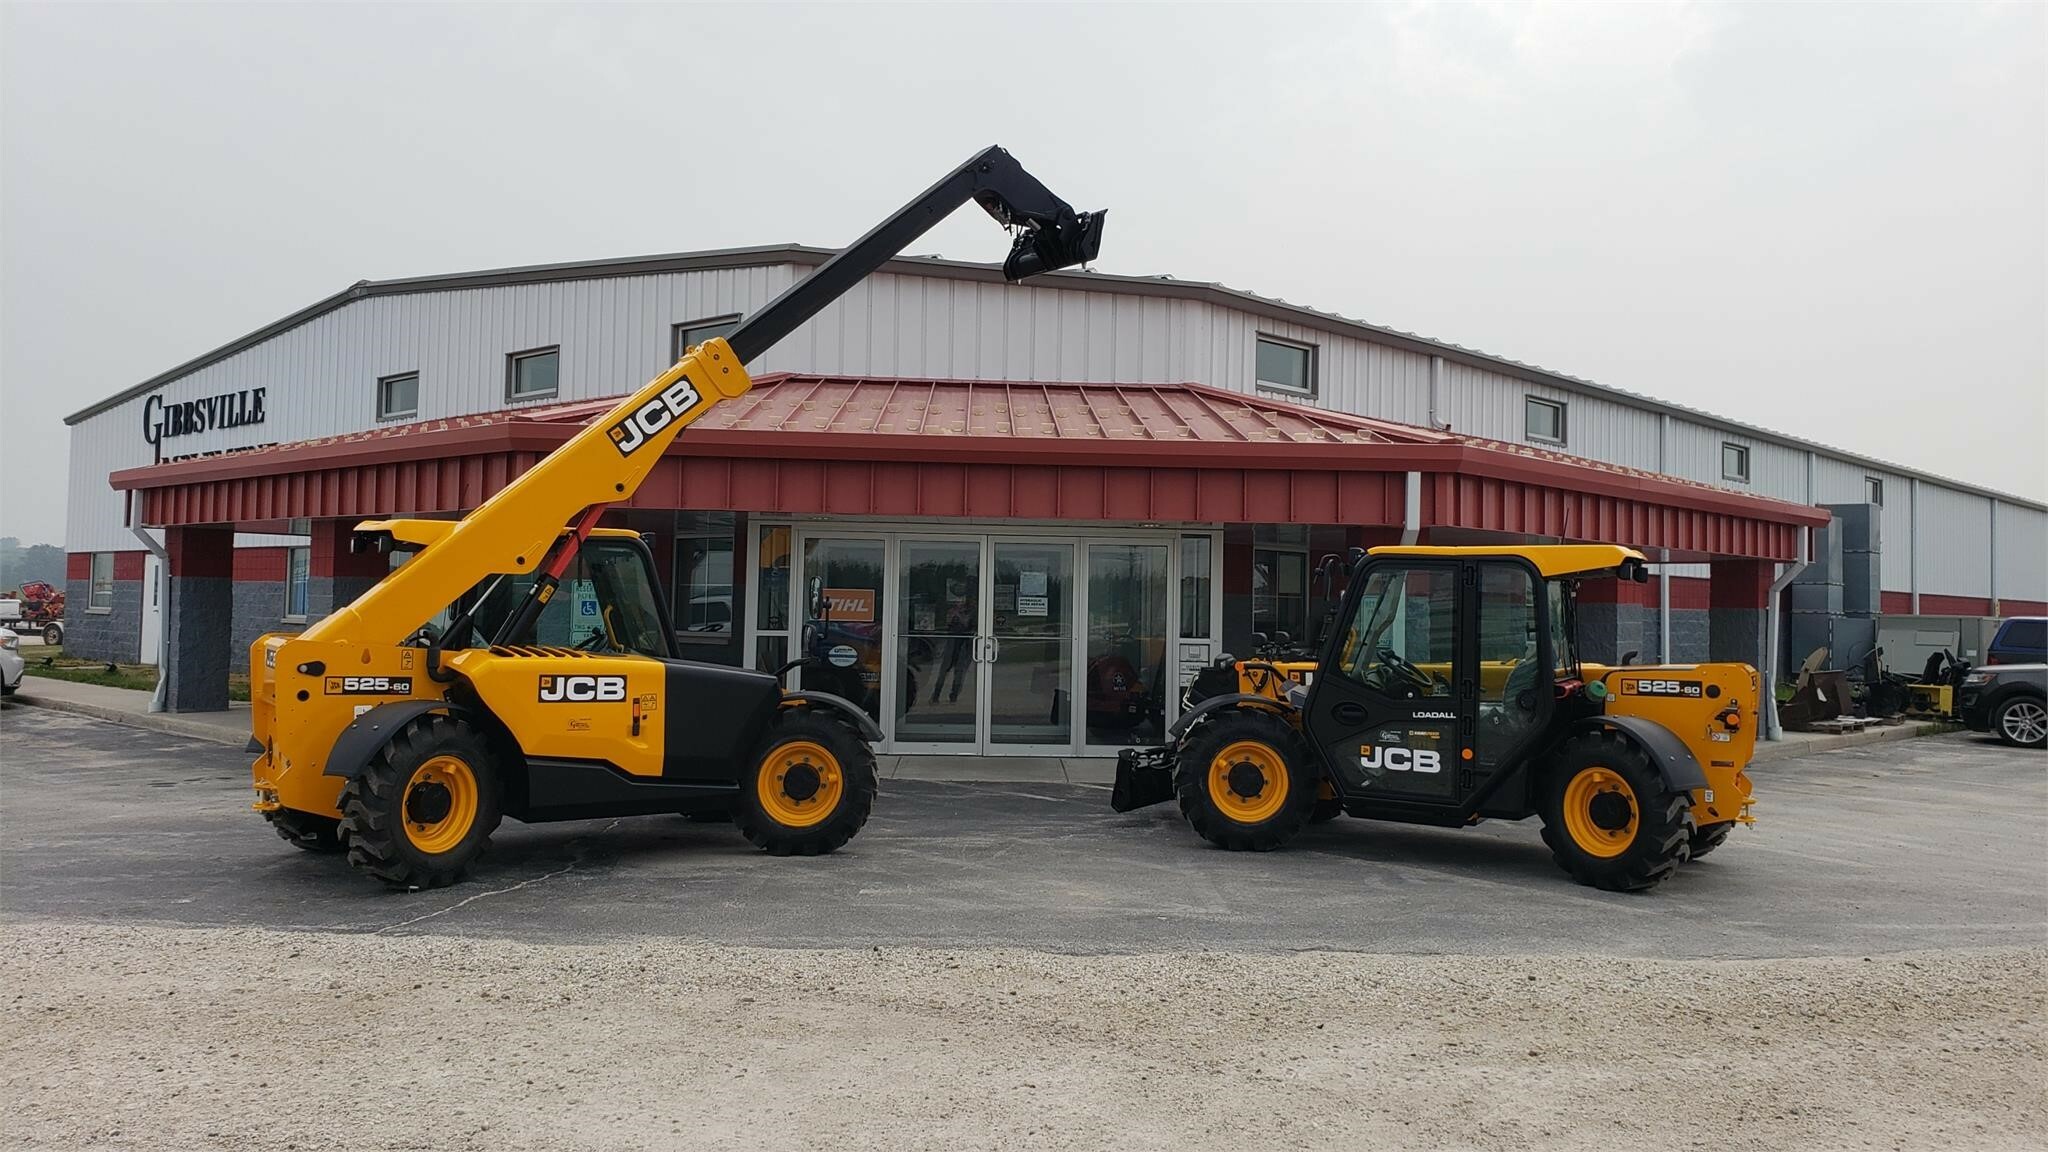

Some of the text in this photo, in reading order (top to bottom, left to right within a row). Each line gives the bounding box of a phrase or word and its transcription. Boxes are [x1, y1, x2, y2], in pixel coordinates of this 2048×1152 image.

[143, 387, 266, 466] GIBBSVILLE
[619, 380, 698, 453] JCB
[344, 677, 410, 691] 525-60
[540, 676, 625, 700] JCB
[1638, 680, 1700, 694] 525-60
[1412, 711, 1457, 719] LOADALL
[1360, 746, 1440, 773] JCB
